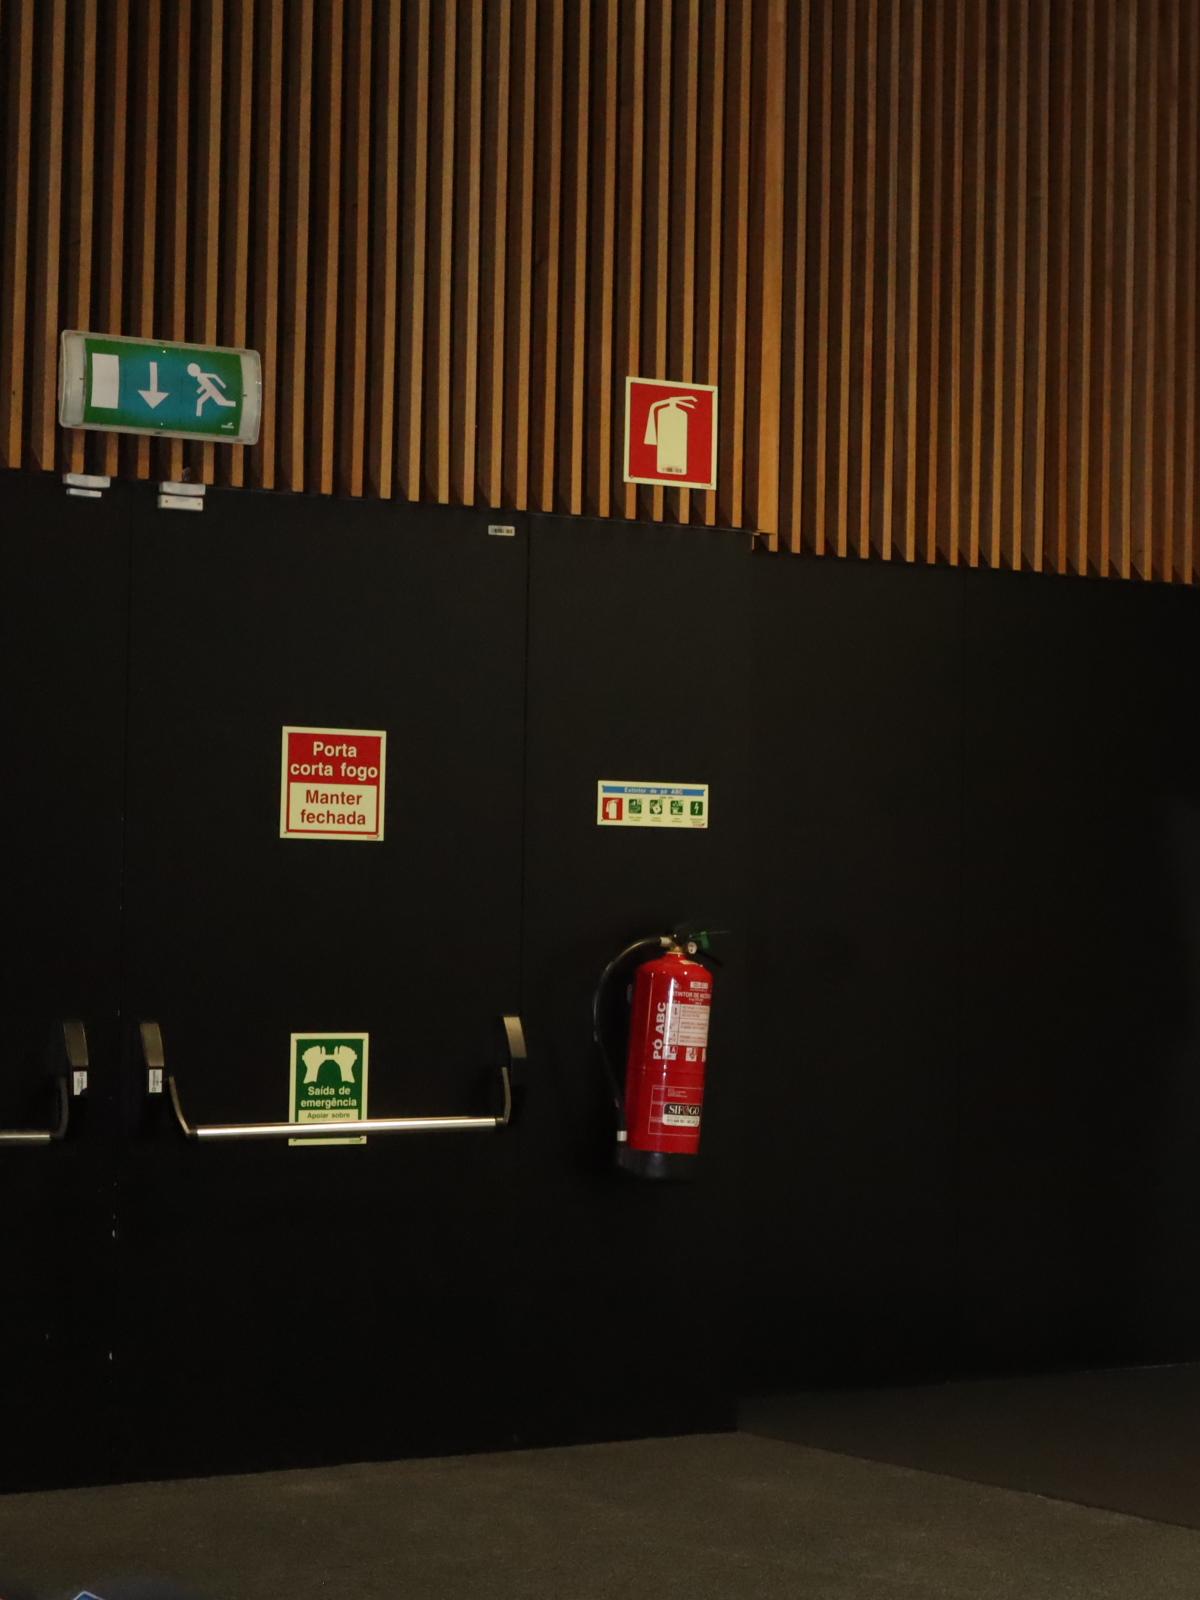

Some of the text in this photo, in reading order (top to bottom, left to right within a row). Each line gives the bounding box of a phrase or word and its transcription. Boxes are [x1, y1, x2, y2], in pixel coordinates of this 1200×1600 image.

[313, 741, 357, 758] Porta
[290, 762, 378, 781] corta fogo
[305, 789, 363, 805] Manter
[300, 809, 366, 825] fechada
[652, 1002, 666, 1060] PÓ ABC
[307, 1086, 351, 1096] Saída de
[300, 1097, 357, 1109] emergência
